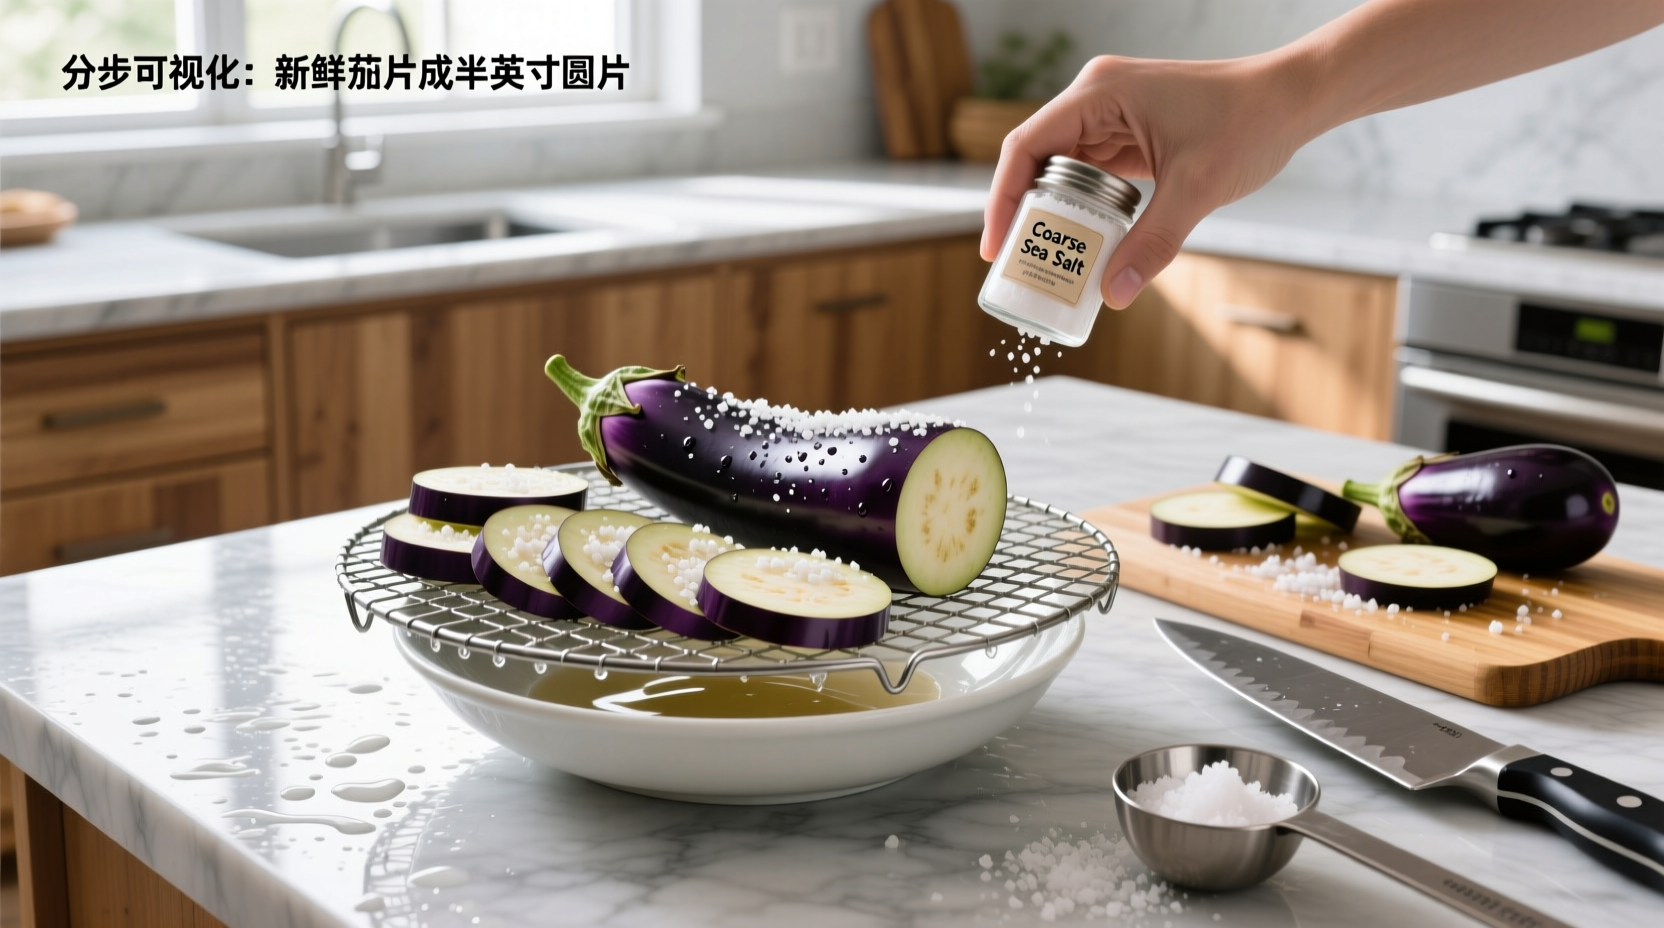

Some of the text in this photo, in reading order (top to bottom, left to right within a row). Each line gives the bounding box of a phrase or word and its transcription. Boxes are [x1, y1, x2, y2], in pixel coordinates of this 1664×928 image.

[1032, 221, 1087, 254] Coarse
[1020, 238, 1049, 261] Sea
[1051, 249, 1086, 276] Salt
